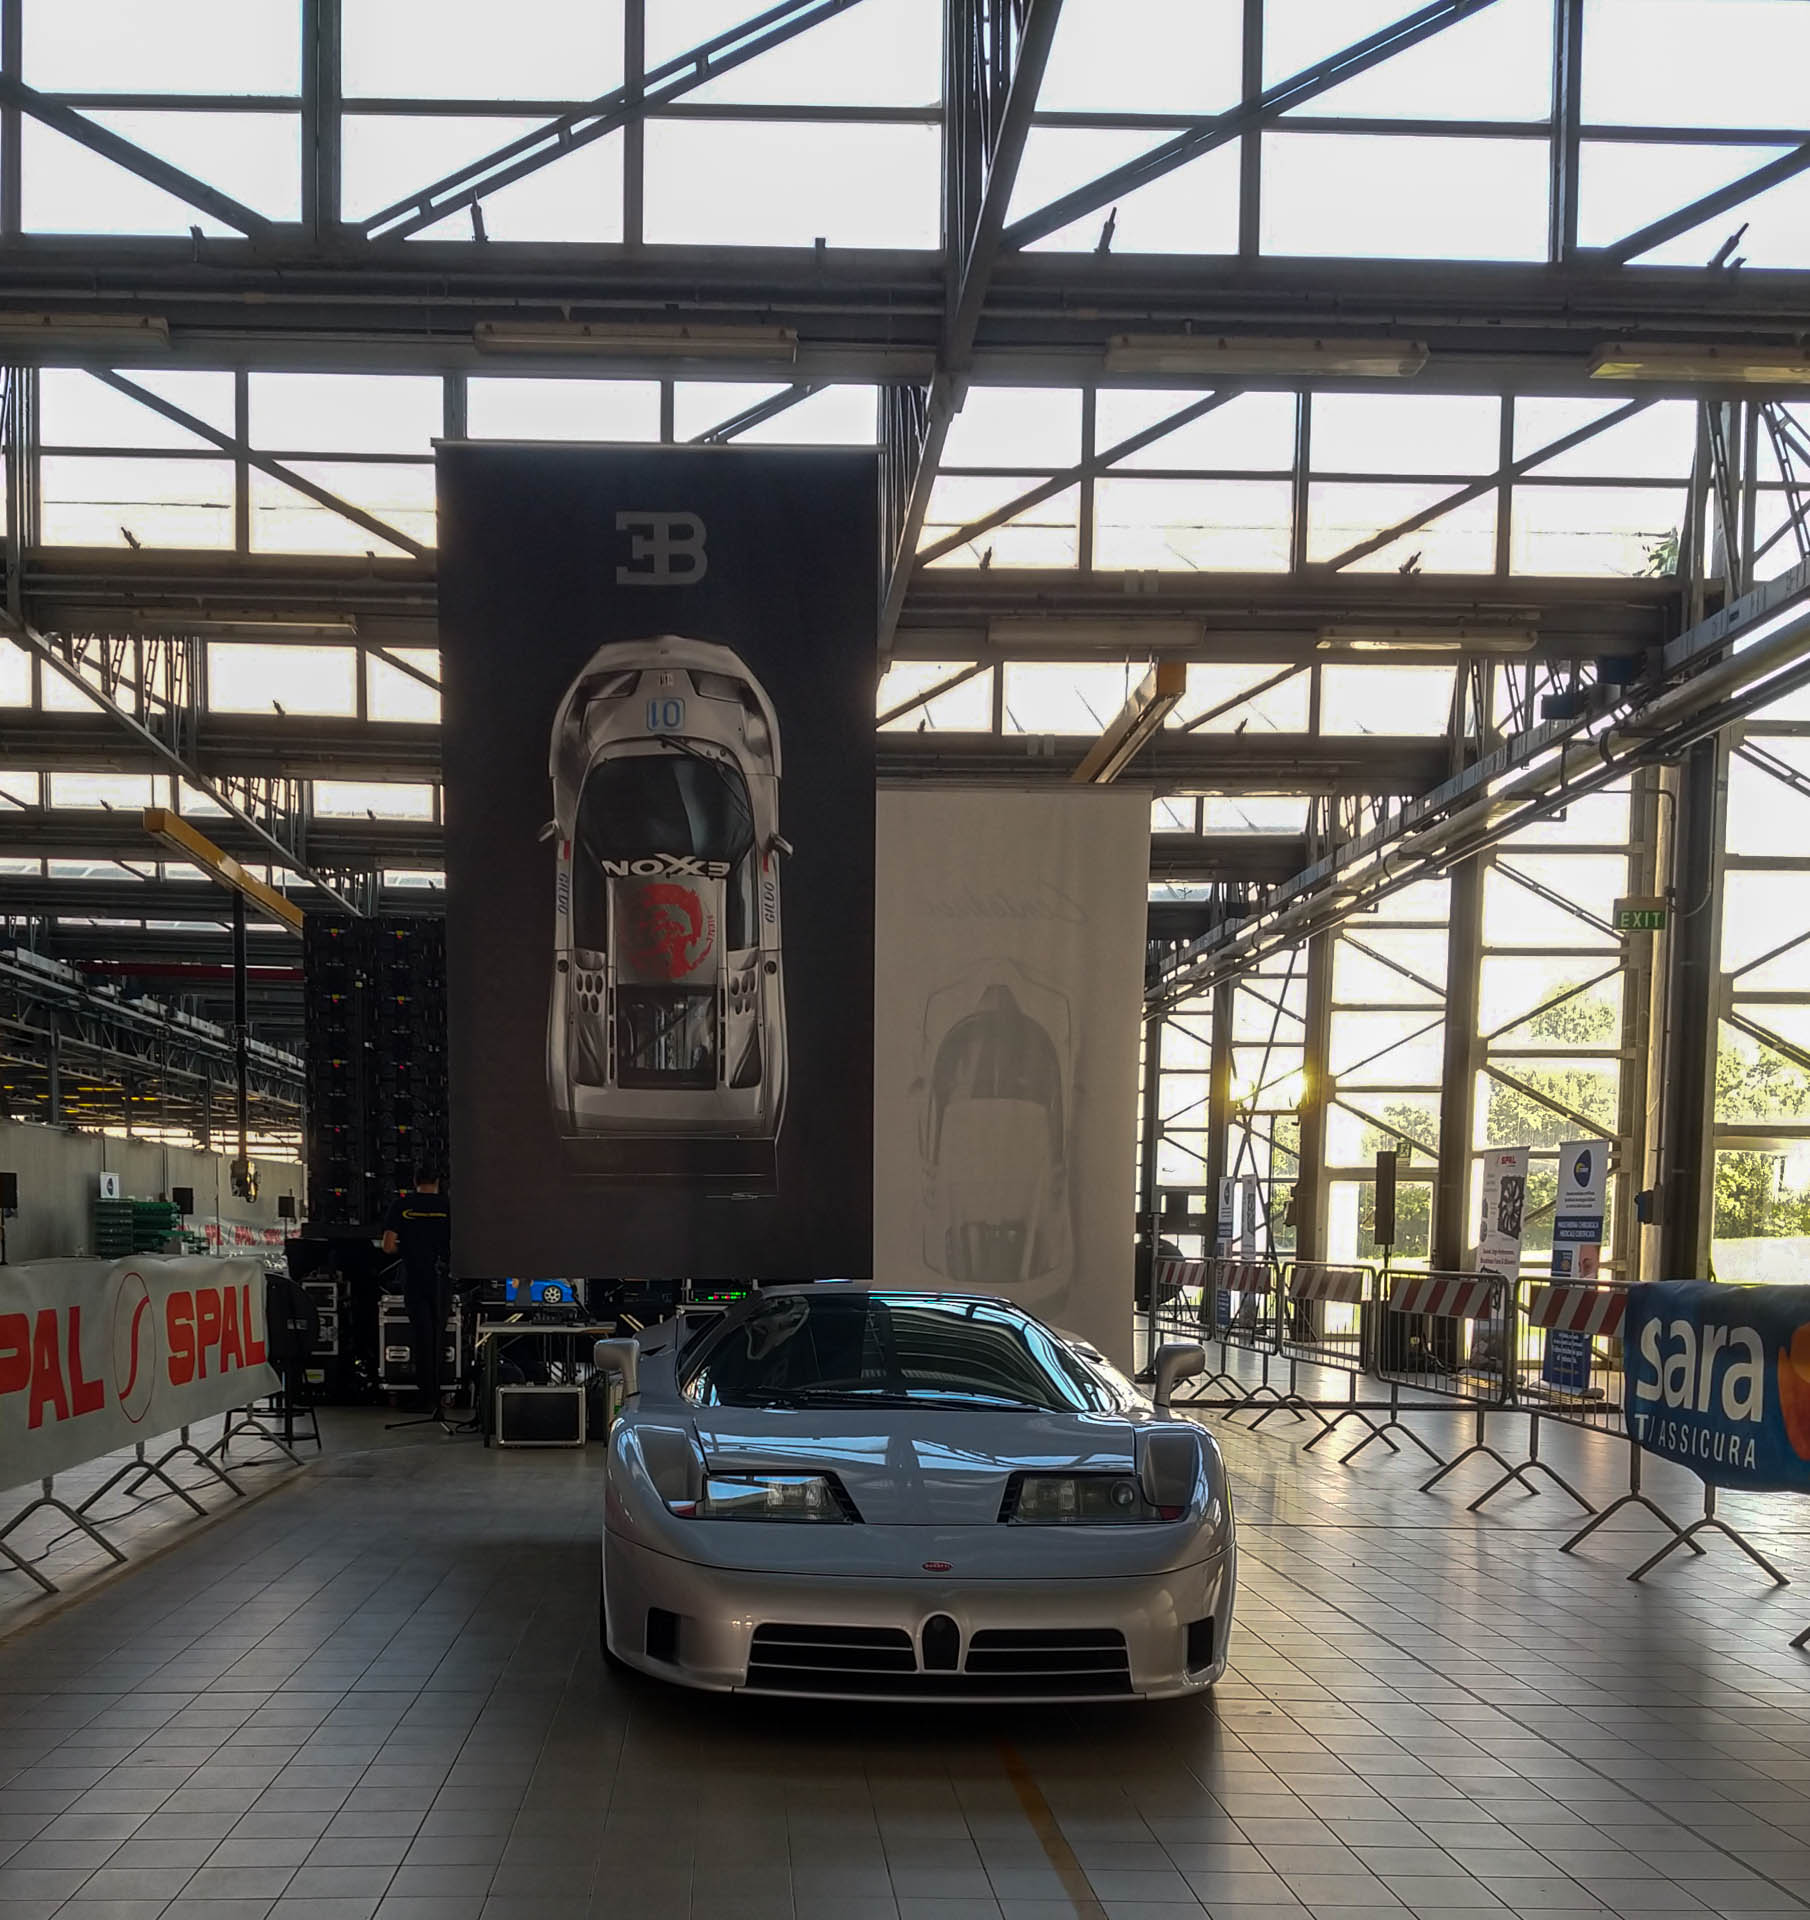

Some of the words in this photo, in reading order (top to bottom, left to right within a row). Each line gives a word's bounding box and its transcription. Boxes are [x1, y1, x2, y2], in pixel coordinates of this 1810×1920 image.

[601, 853, 731, 876] EXXON
[557, 872, 570, 915] GILDO
[765, 881, 777, 924] GILDO
[1620, 911, 1661, 928] EXIT
[166, 1284, 266, 1386] SPAL
[1636, 1317, 1765, 1423] sara
